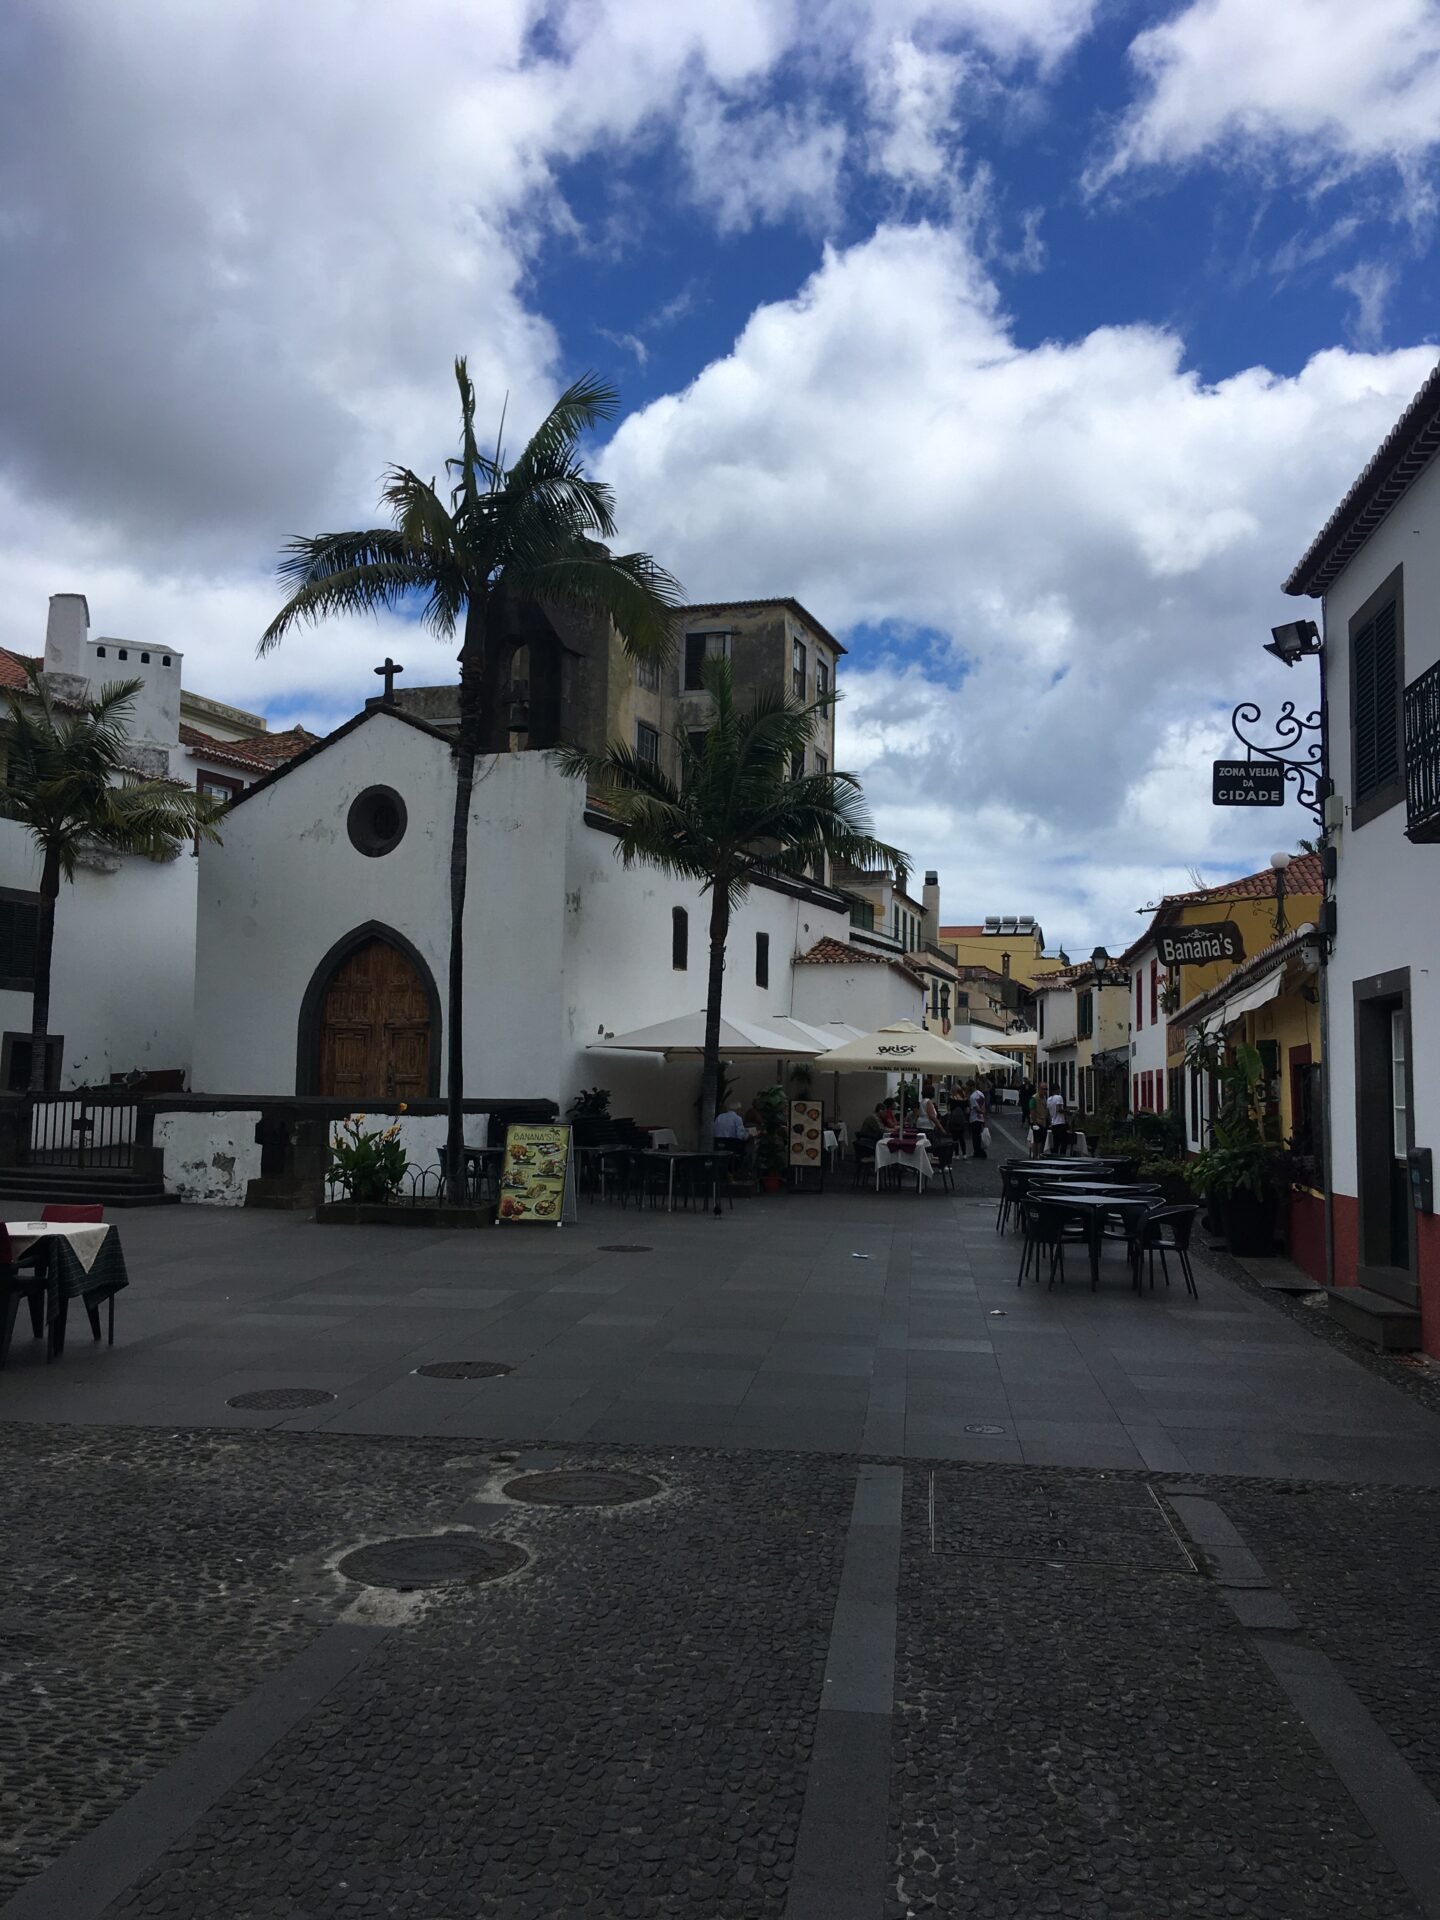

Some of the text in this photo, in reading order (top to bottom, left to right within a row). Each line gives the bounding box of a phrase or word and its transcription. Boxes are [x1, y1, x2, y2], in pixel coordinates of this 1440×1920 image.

[1218, 767, 1280, 777] ZONA VELHA
[1242, 779, 1254, 787] DA
[1218, 790, 1280, 801] CIDADE
[1163, 933, 1233, 961] Banana's
